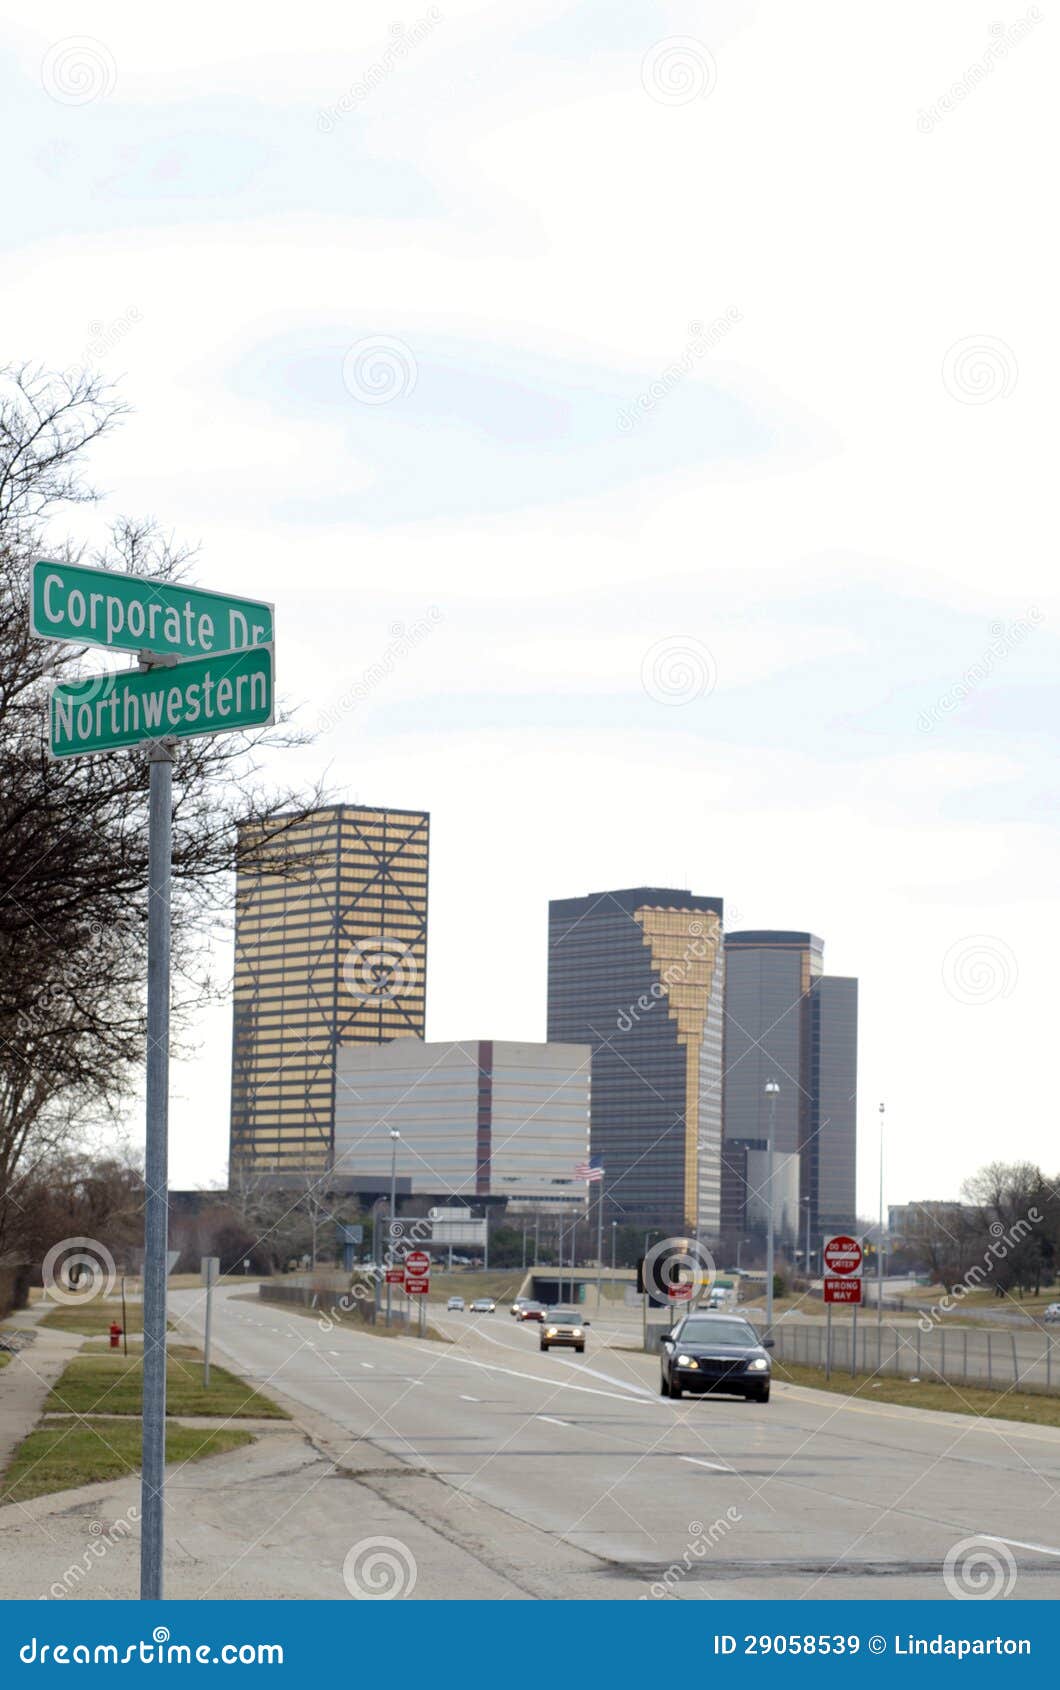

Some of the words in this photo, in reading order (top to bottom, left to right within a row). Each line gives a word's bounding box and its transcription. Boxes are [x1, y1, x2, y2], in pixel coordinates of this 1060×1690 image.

[43, 574, 215, 651] Corporate
[229, 608, 265, 650] Dr
[54, 671, 267, 743] Northwestern
[827, 1282, 858, 1290] WRONG
[833, 1292, 852, 1300] WAY
